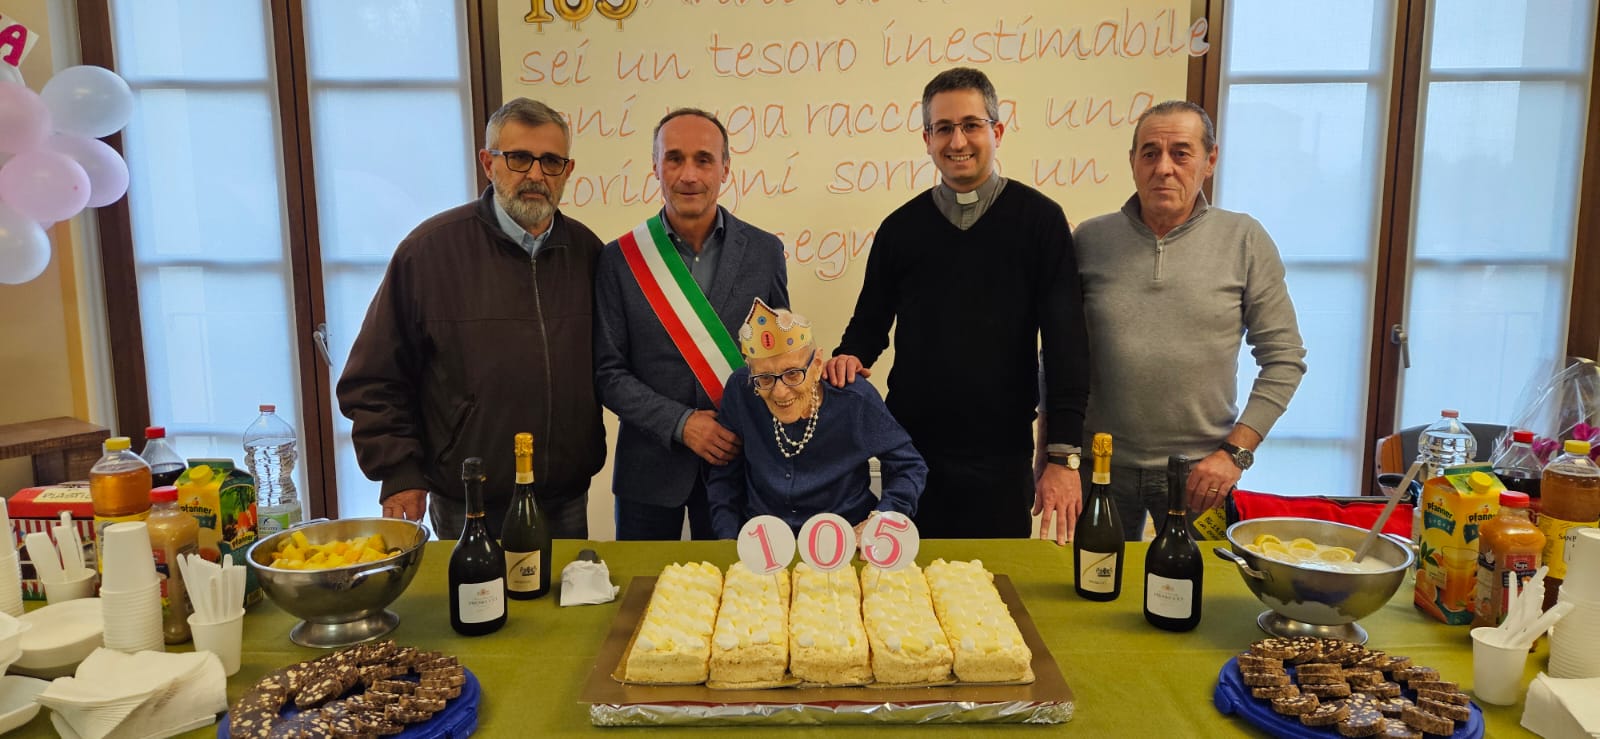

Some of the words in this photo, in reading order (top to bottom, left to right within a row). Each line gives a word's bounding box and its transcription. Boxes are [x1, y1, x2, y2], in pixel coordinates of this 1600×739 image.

[520, 39, 591, 85] sei
[617, 51, 690, 82] un
[710, 33, 857, 77] tesoro
[884, 8, 1209, 65] inestimabile
[1034, 157, 1109, 187] un
